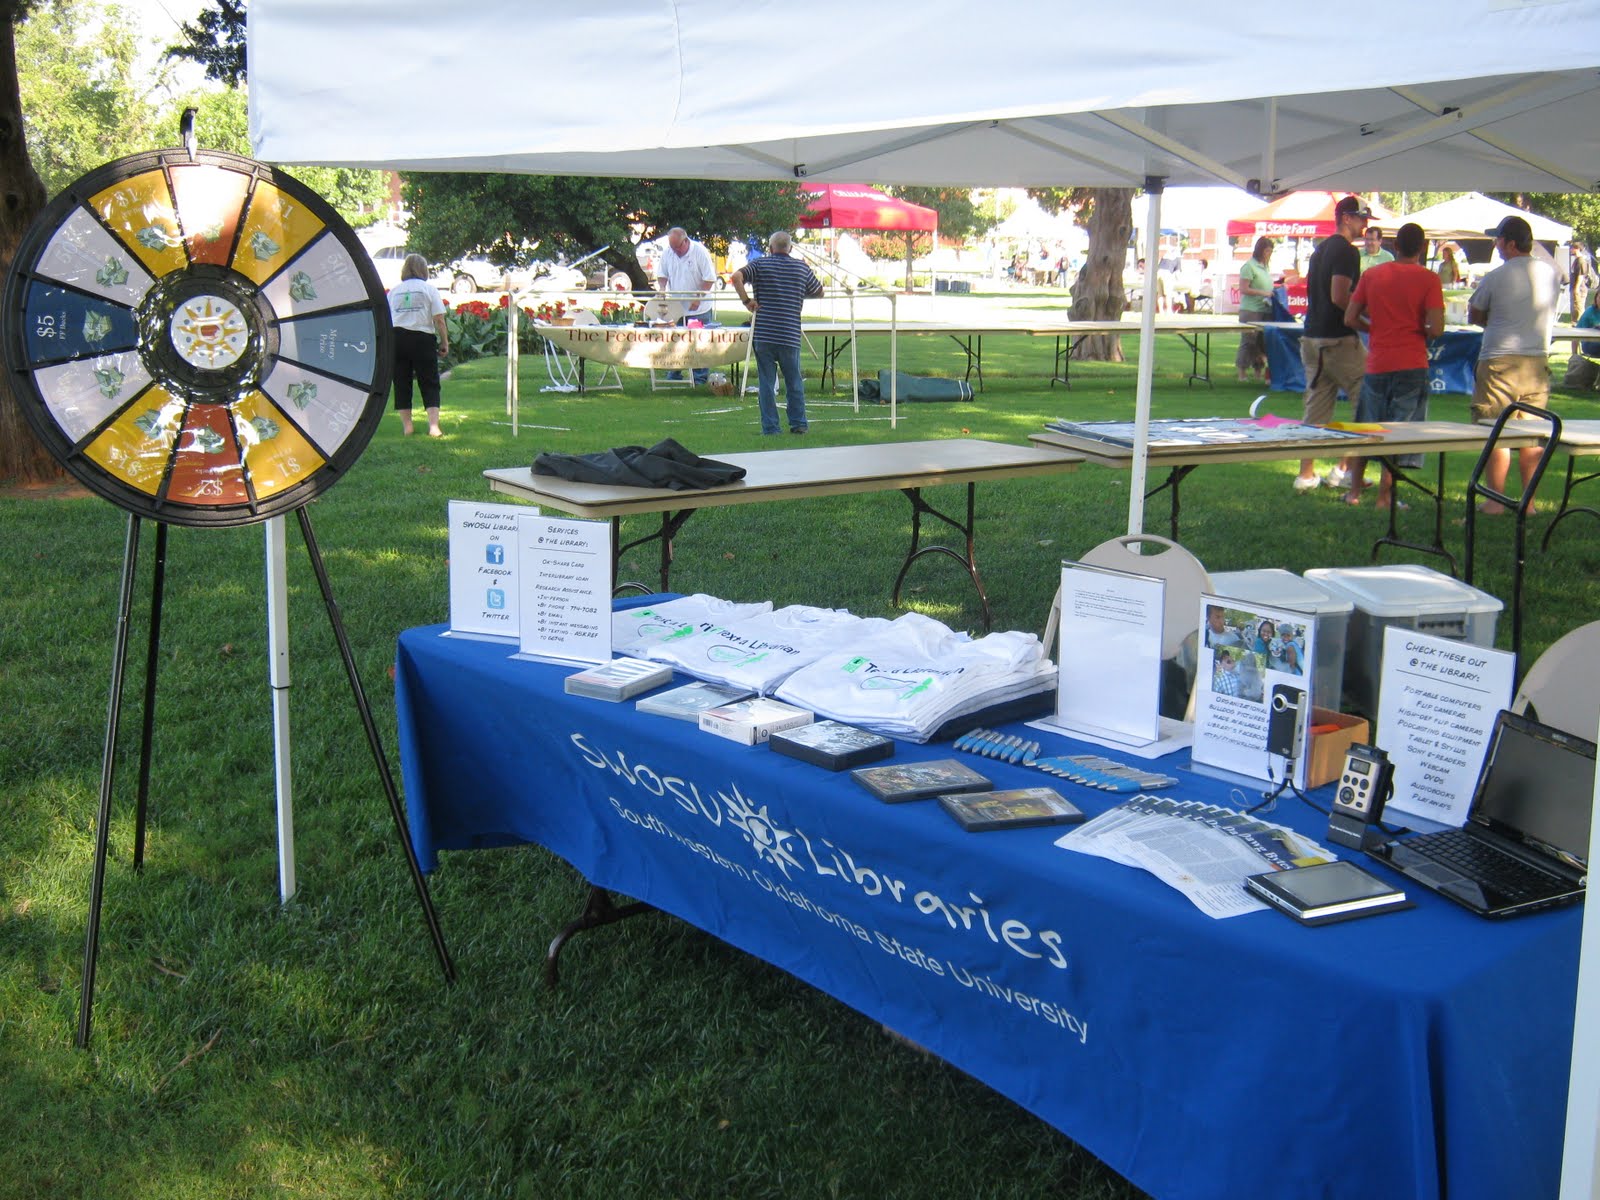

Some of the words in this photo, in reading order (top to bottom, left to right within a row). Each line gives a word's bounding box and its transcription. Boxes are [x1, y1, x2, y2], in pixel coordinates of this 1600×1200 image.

[36, 315, 57, 338] $5
[566, 328, 600, 343] The
[605, 329, 693, 344] Federated
[698, 329, 749, 344] Churc
[320, 333, 328, 354] Prize
[328, 328, 337, 361] Mystery
[474, 511, 501, 521] FOLLOW
[462, 521, 491, 530] SWOSU
[492, 524, 519, 532] LIBRARI
[547, 526, 579, 536] SERVICES
[478, 566, 512, 576] FACEBOOK
[482, 612, 510, 621] TWITTER
[1405, 642, 1437, 657] CHECK
[1438, 651, 1466, 663] THESE
[1469, 657, 1488, 668] OUT
[1409, 658, 1419, 667] @
[1420, 661, 1438, 671] THE
[1439, 666, 1480, 683] LIBRARY:
[1403, 685, 1438, 699] PORTABLE
[1439, 693, 1482, 711] COMPUTERS
[1208, 704, 1235, 715] BULLDOG
[1236, 711, 1266, 723] PICTURES
[1416, 700, 1432, 710] FLIP
[1433, 706, 1466, 719] CAMERAS
[1238, 729, 1268, 741] FACEBOO
[1397, 719, 1440, 736] PODCASTING
[1441, 731, 1482, 747] EQUIPMENT
[1450, 721, 1484, 736] CAMERAS
[1407, 745, 1427, 757] SONY
[1408, 733, 1434, 746] TABLET
[1440, 742, 1467, 756] STYLUS
[1419, 761, 1451, 774] WEBCAM
[571, 733, 725, 828] SWOSU
[1410, 781, 1456, 800] AUDIOBOOKS
[795, 826, 1069, 969] Libraries
[752, 869, 873, 945] Oklahoma
[873, 930, 945, 977] State
[947, 960, 1088, 1045] University
